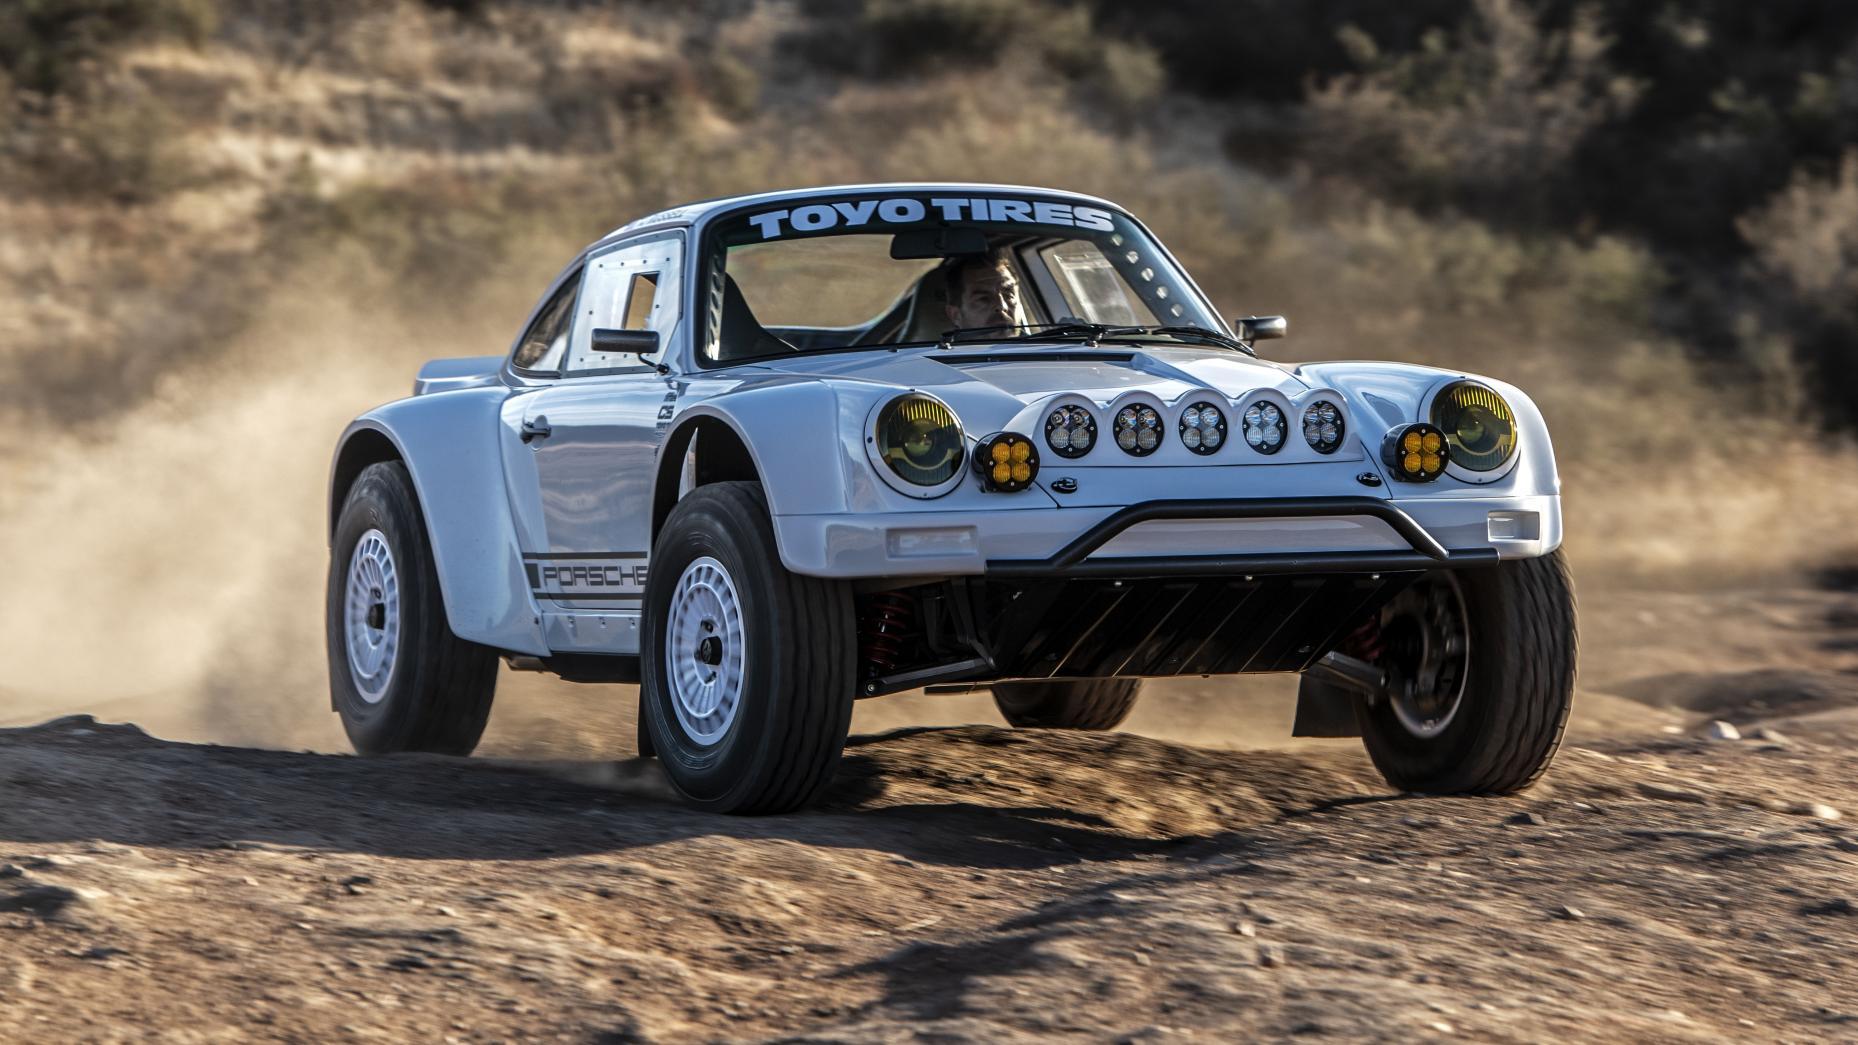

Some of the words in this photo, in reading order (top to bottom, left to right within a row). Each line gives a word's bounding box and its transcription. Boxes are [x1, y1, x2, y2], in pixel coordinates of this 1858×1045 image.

[749, 198, 925, 239] TOYO
[931, 198, 1115, 232] TIRES
[543, 566, 648, 586] PORSCHE
